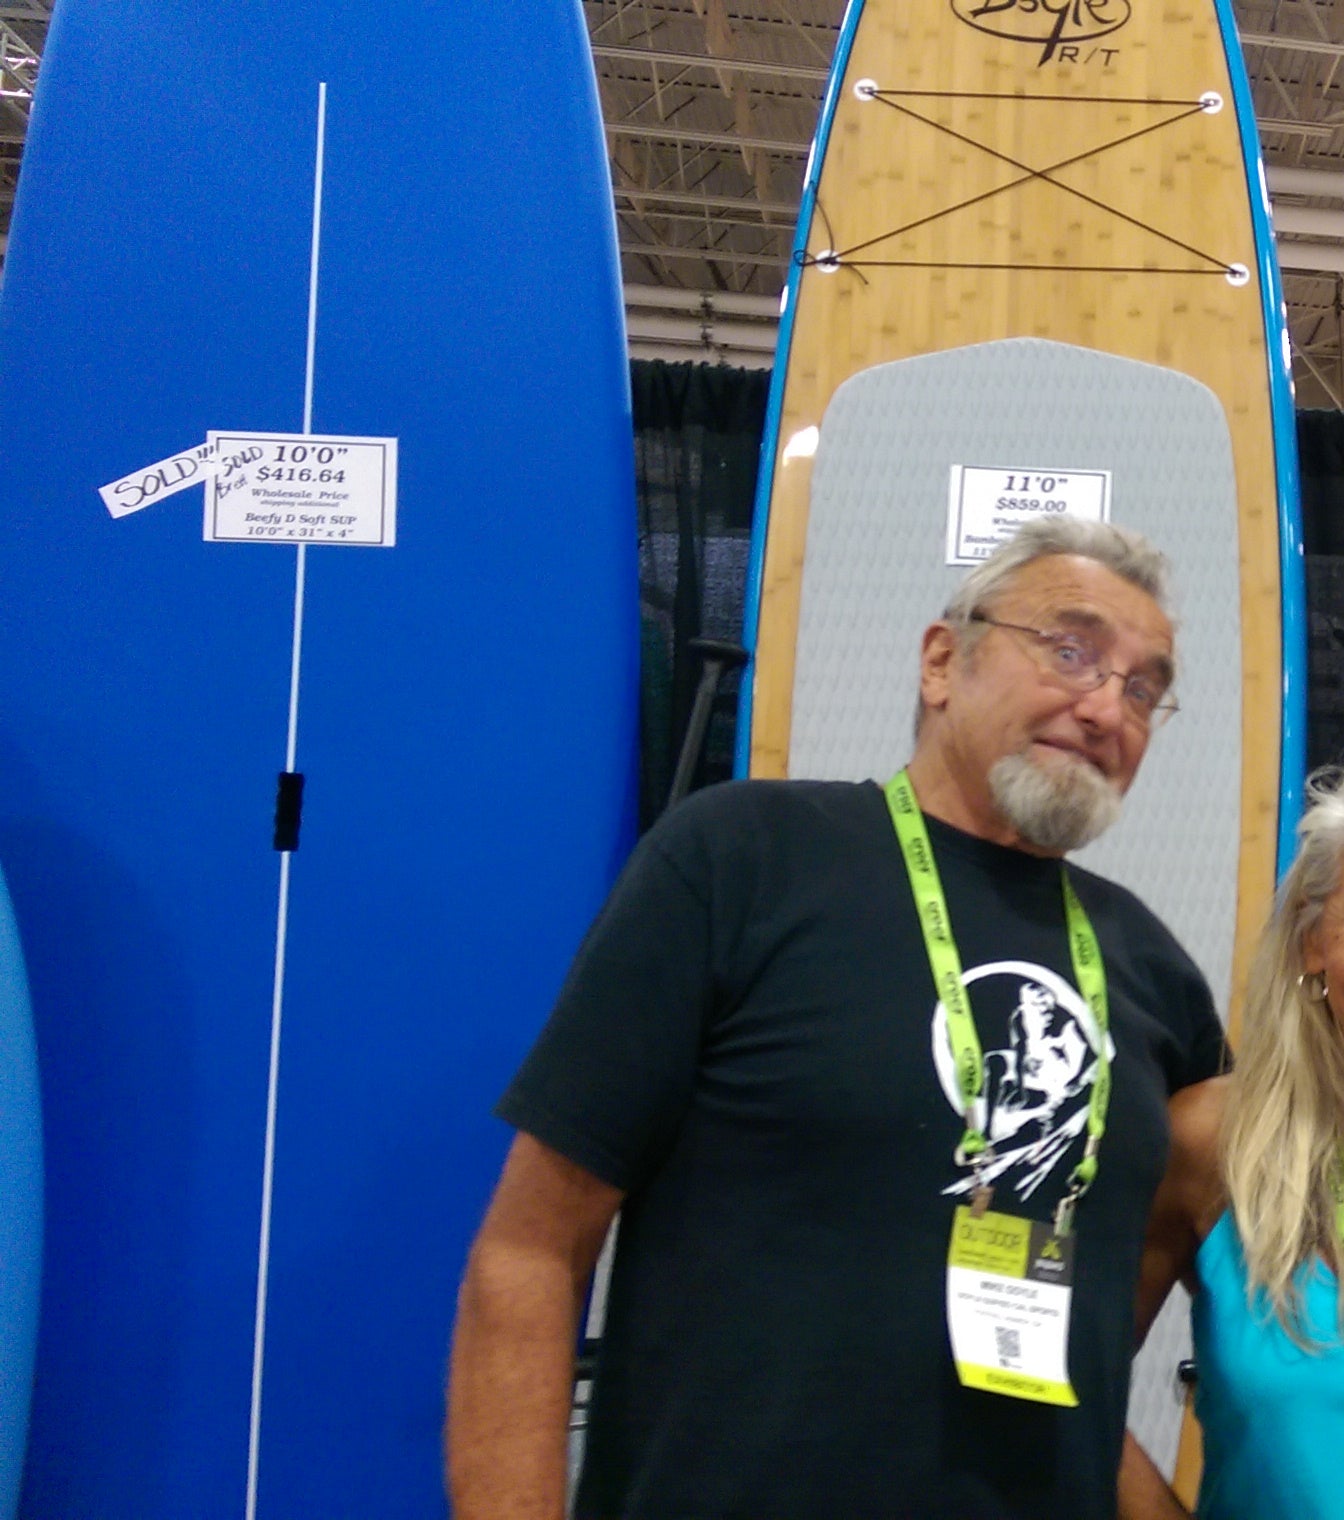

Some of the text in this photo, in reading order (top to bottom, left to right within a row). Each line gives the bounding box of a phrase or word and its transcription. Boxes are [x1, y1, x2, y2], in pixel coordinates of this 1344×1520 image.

[1059, 46, 1119, 66] R/T
[256, 465, 345, 484] $416.64
[251, 488, 349, 500] Wholesale Price
[996, 497, 1067, 512] $859.00
[245, 512, 357, 525] Beefy D Soft SUP
